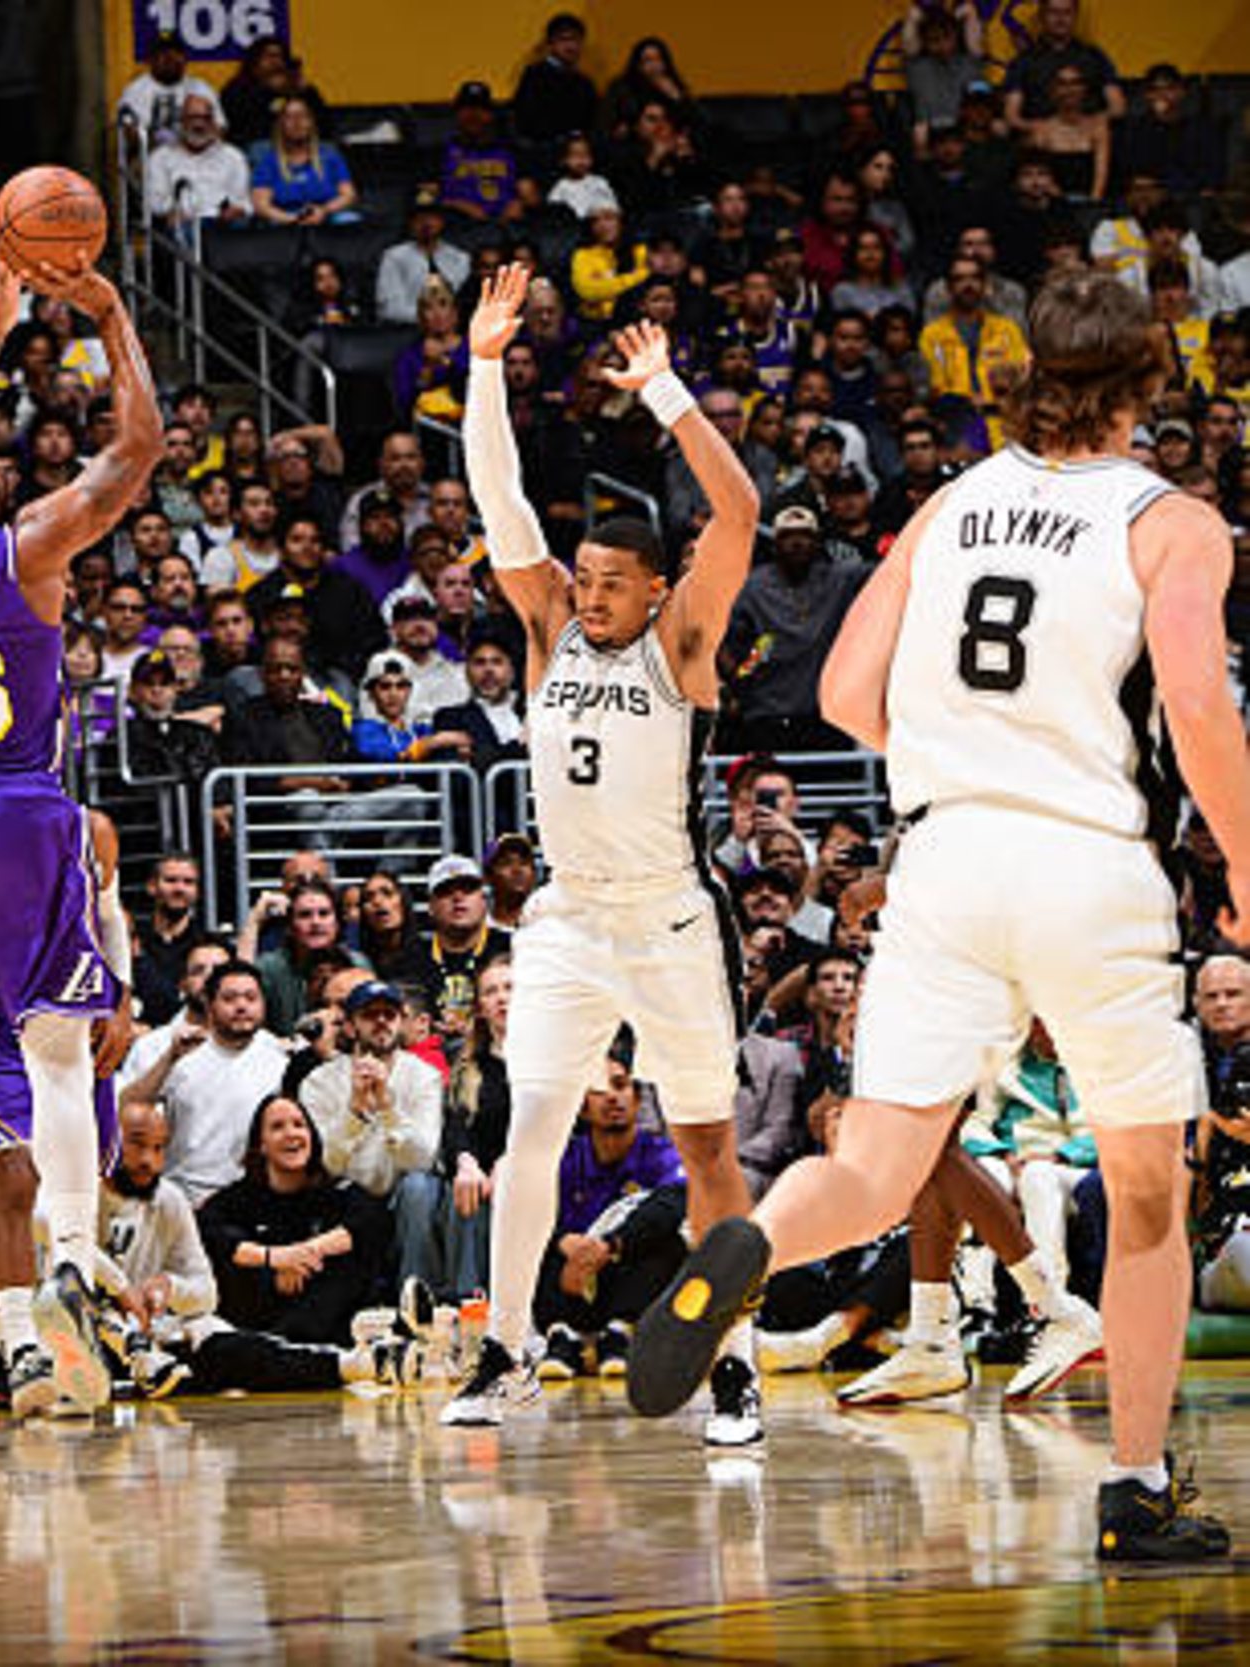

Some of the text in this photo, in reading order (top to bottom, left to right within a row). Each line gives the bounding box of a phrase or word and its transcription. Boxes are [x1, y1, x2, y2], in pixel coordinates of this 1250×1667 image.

[147, 0, 275, 49] 106
[960, 508, 1091, 556] OLYNYK
[959, 575, 1037, 692] 8
[543, 681, 651, 717] SPURS
[568, 736, 600, 785] 3
